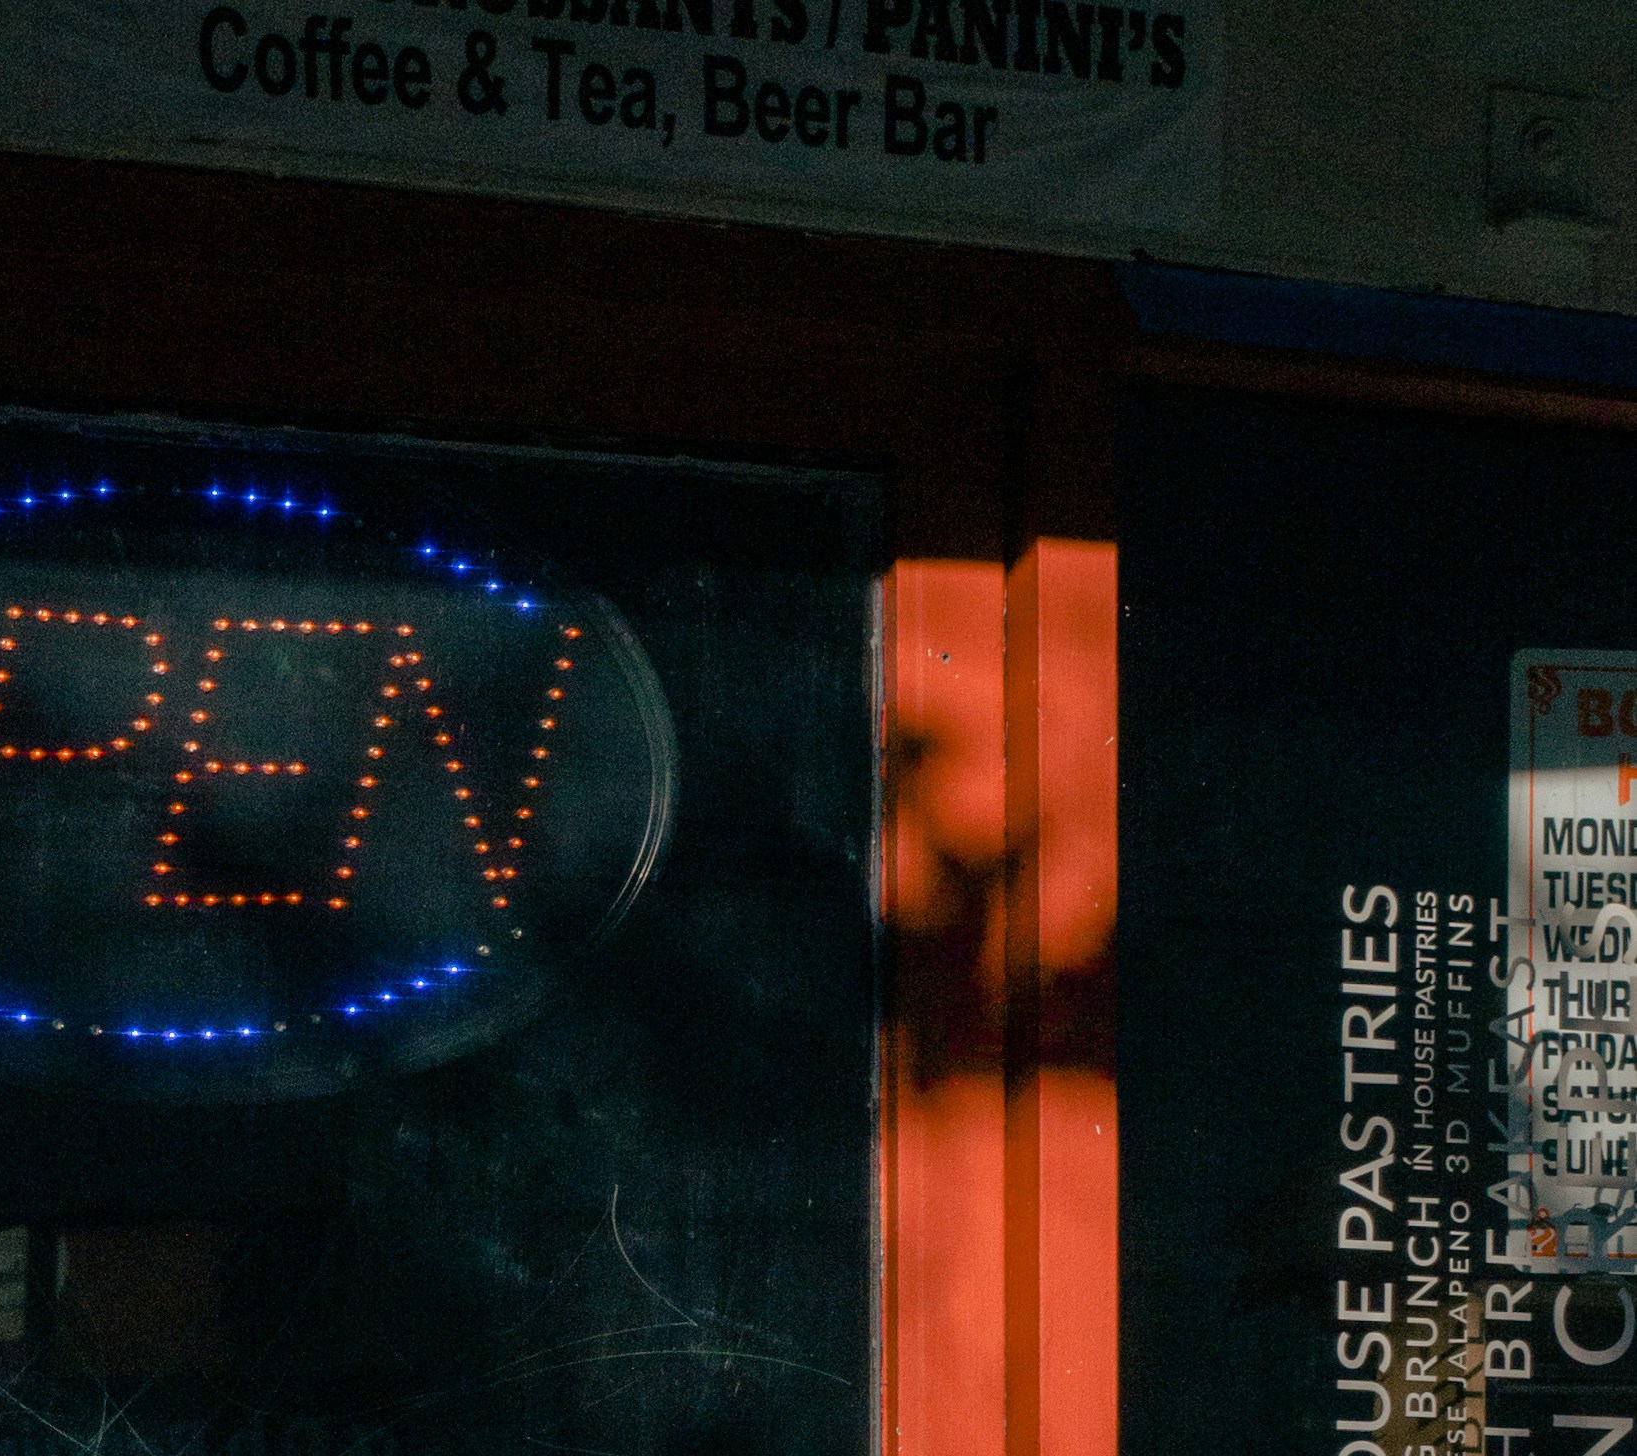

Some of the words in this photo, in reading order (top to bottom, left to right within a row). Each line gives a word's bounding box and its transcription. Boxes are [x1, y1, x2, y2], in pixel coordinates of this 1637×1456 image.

[198, 6, 432, 109] Coffee
[461, 30, 510, 117] &
[531, 37, 674, 148] Tea,
[703, 54, 862, 150] Beer
[885, 73, 999, 164] Bar
[1414, 889, 1439, 1020] PASTRIES
[1447, 892, 1474, 1095] MUFFINS
[1337, 883, 1400, 1252] PASTRIES
[1413, 1028, 1435, 1130] HOUSE
[1445, 1119, 1470, 1174] 3D
[1405, 1196, 1441, 1419] BRUNCH
